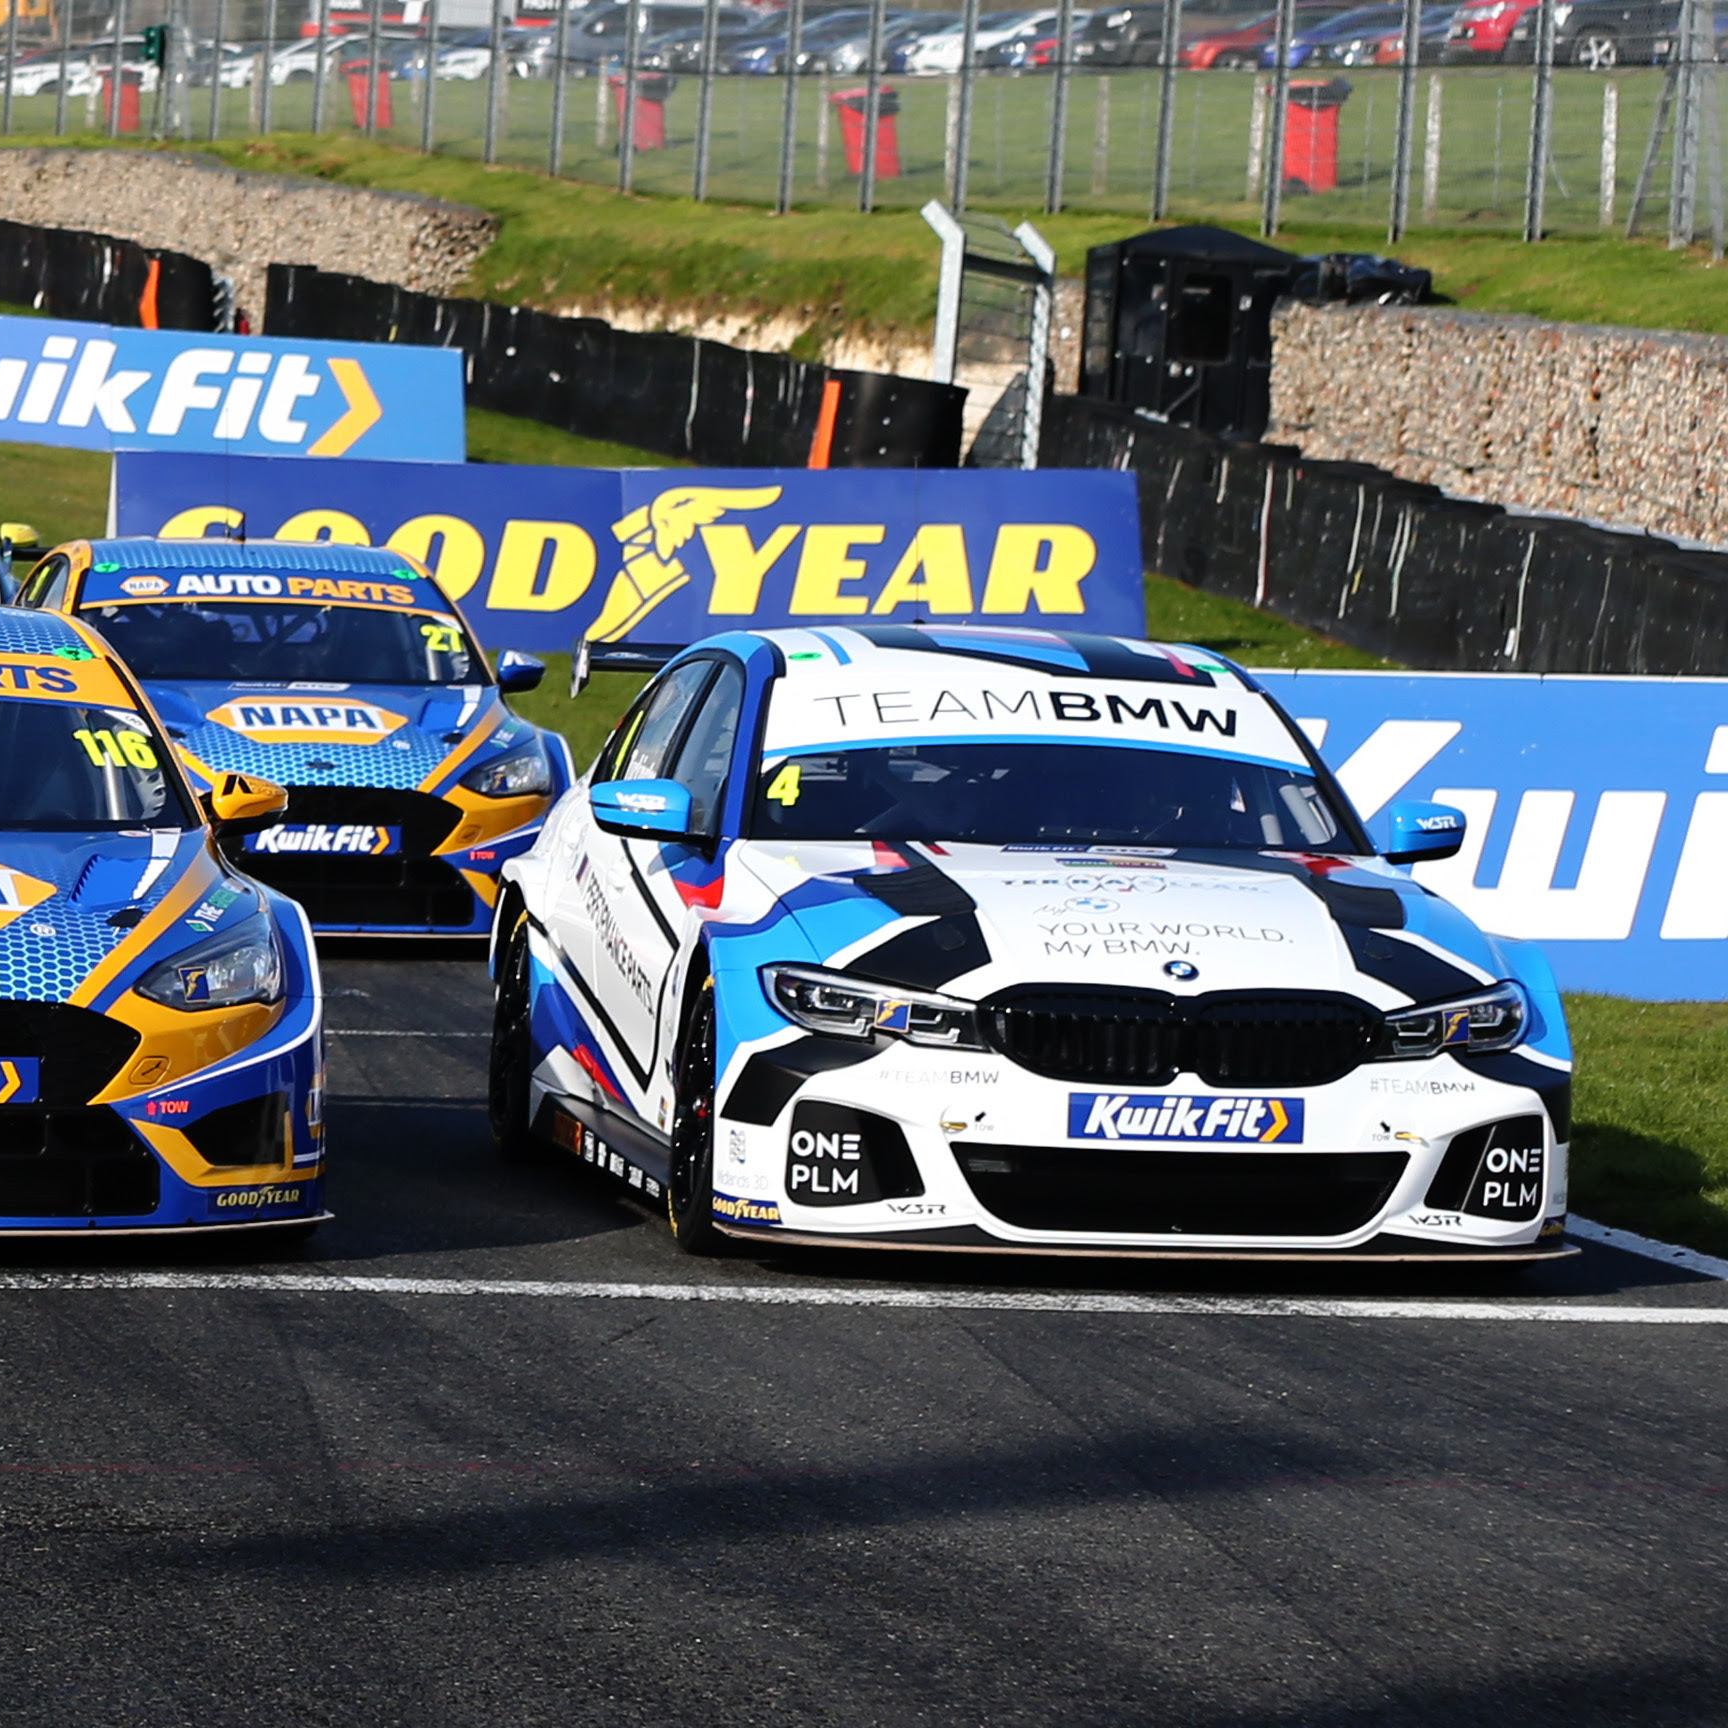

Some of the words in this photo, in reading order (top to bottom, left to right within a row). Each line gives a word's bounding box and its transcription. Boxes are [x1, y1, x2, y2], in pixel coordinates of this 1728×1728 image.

[176, 574, 283, 596] AUTO
[286, 575, 416, 605] PARTS
[420, 624, 463, 653] 27
[240, 705, 377, 730] NAPA
[72, 728, 159, 770] 116
[766, 764, 802, 807] 4
[1037, 921, 1141, 939] YOUR
[1043, 940, 1091, 959] My
[158, 1099, 190, 1114] TOW
[791, 1130, 862, 1160] ONE
[1485, 1147, 1543, 1174] ONE
[791, 1163, 860, 1195] PLM
[1482, 1180, 1538, 1208] PLM
[1407, 1214, 1464, 1227] WSR
